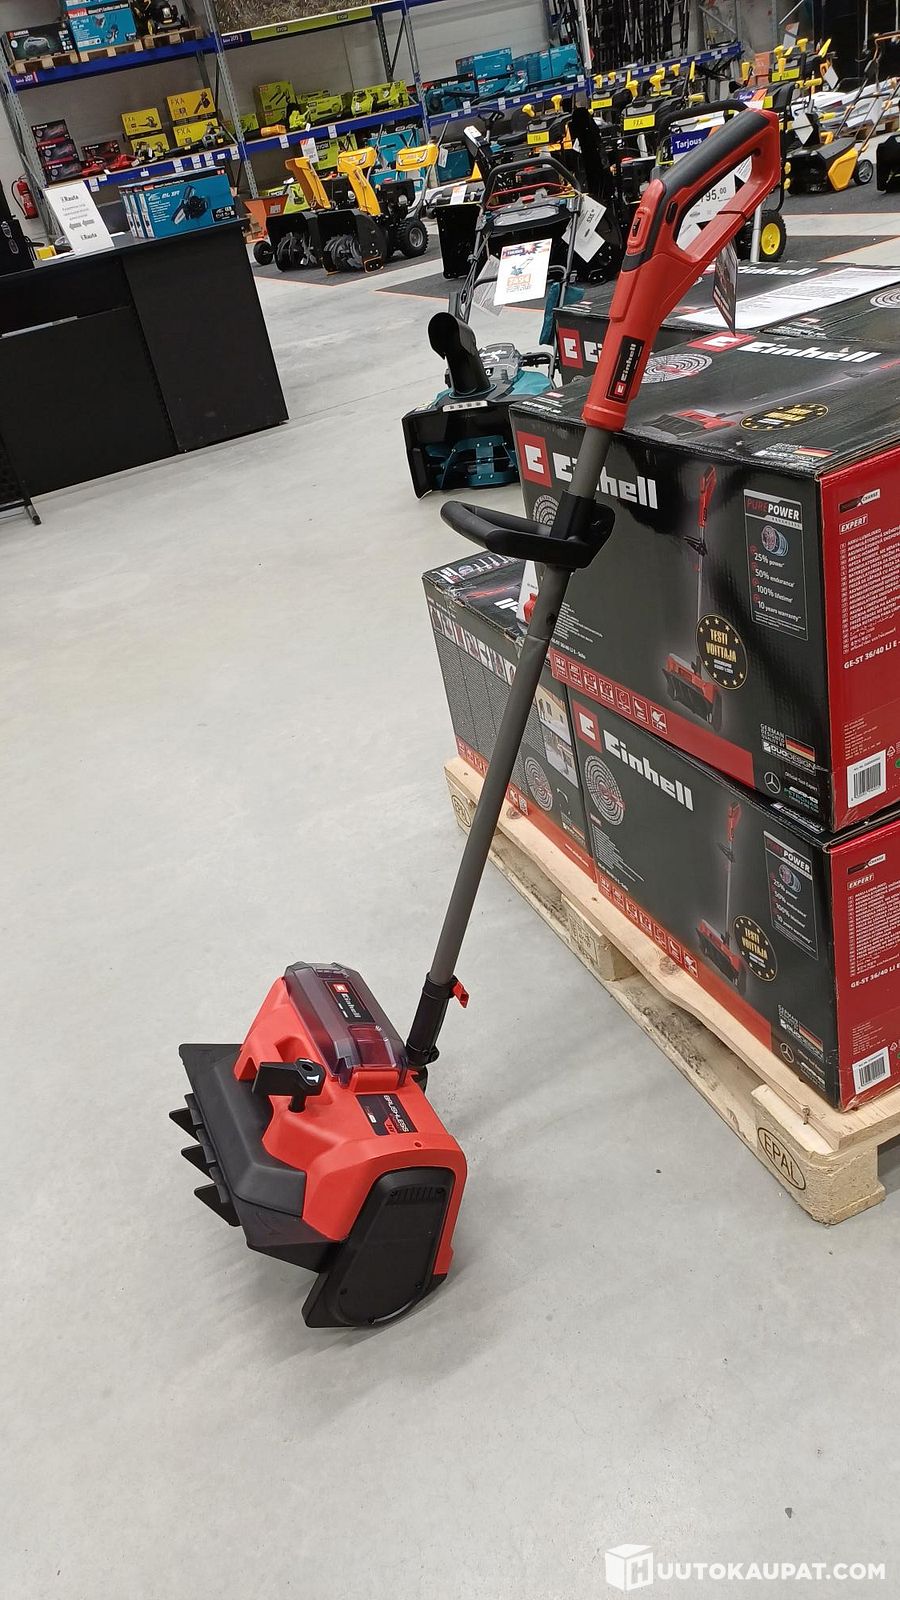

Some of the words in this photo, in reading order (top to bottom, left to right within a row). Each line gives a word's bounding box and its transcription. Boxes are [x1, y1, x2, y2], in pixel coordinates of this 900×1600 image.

[632, 118, 644, 127] FXA
[675, 137, 703, 149] Tarjous
[736, 341, 882, 363] Einhell
[620, 343, 637, 382] Einhell
[552, 452, 658, 509] Ehell
[841, 516, 868, 533] EXPERT
[754, 552, 769, 564] 25%
[755, 568, 770, 580] 50%
[756, 585, 774, 597] 100%
[757, 600, 765, 610] 10
[765, 605, 778, 616] years
[710, 628, 728, 645] TESTI
[706, 641, 737, 663] VOITTAJA
[843, 653, 864, 670] GE-ST
[864, 645, 885, 662] 36/40
[760, 723, 784, 738] GERMAN
[603, 729, 694, 812] Einhell
[849, 874, 873, 889] EXPERT
[744, 927, 760, 945] TESTI
[741, 936, 769, 961] VOITTAJA
[850, 976, 870, 989] GE-ST
[341, 992, 362, 1019] Einhell
[383, 1095, 410, 1133] BRUSHLESS
[763, 1133, 799, 1186] EPAL
